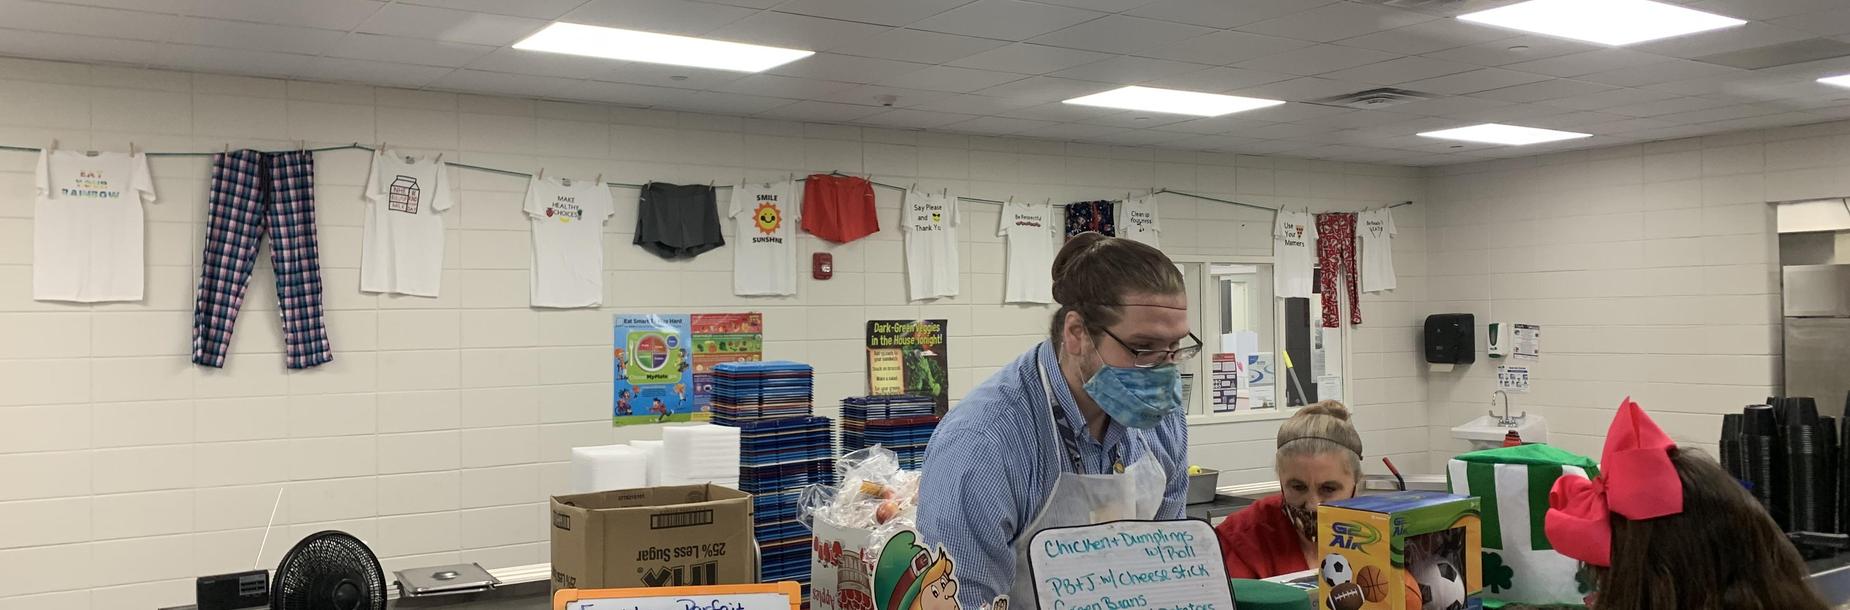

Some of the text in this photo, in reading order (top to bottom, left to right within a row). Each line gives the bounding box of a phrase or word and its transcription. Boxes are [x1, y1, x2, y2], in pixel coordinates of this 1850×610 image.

[61, 188, 120, 198] RAINBOW
[557, 195, 575, 203] MAKE
[552, 202, 579, 210] HEALTHY
[913, 203, 943, 212] Say Please
[553, 209, 578, 218] CHOICES
[874, 322, 941, 335] Dark-Green Veggies
[871, 333, 943, 347] in the House Tonight!
[636, 542, 726, 562] 25% Less Sugar
[1144, 545, 1196, 564] w/ Roll
[1119, 570, 1171, 586] Cheese
[1100, 594, 1147, 610] Beans
